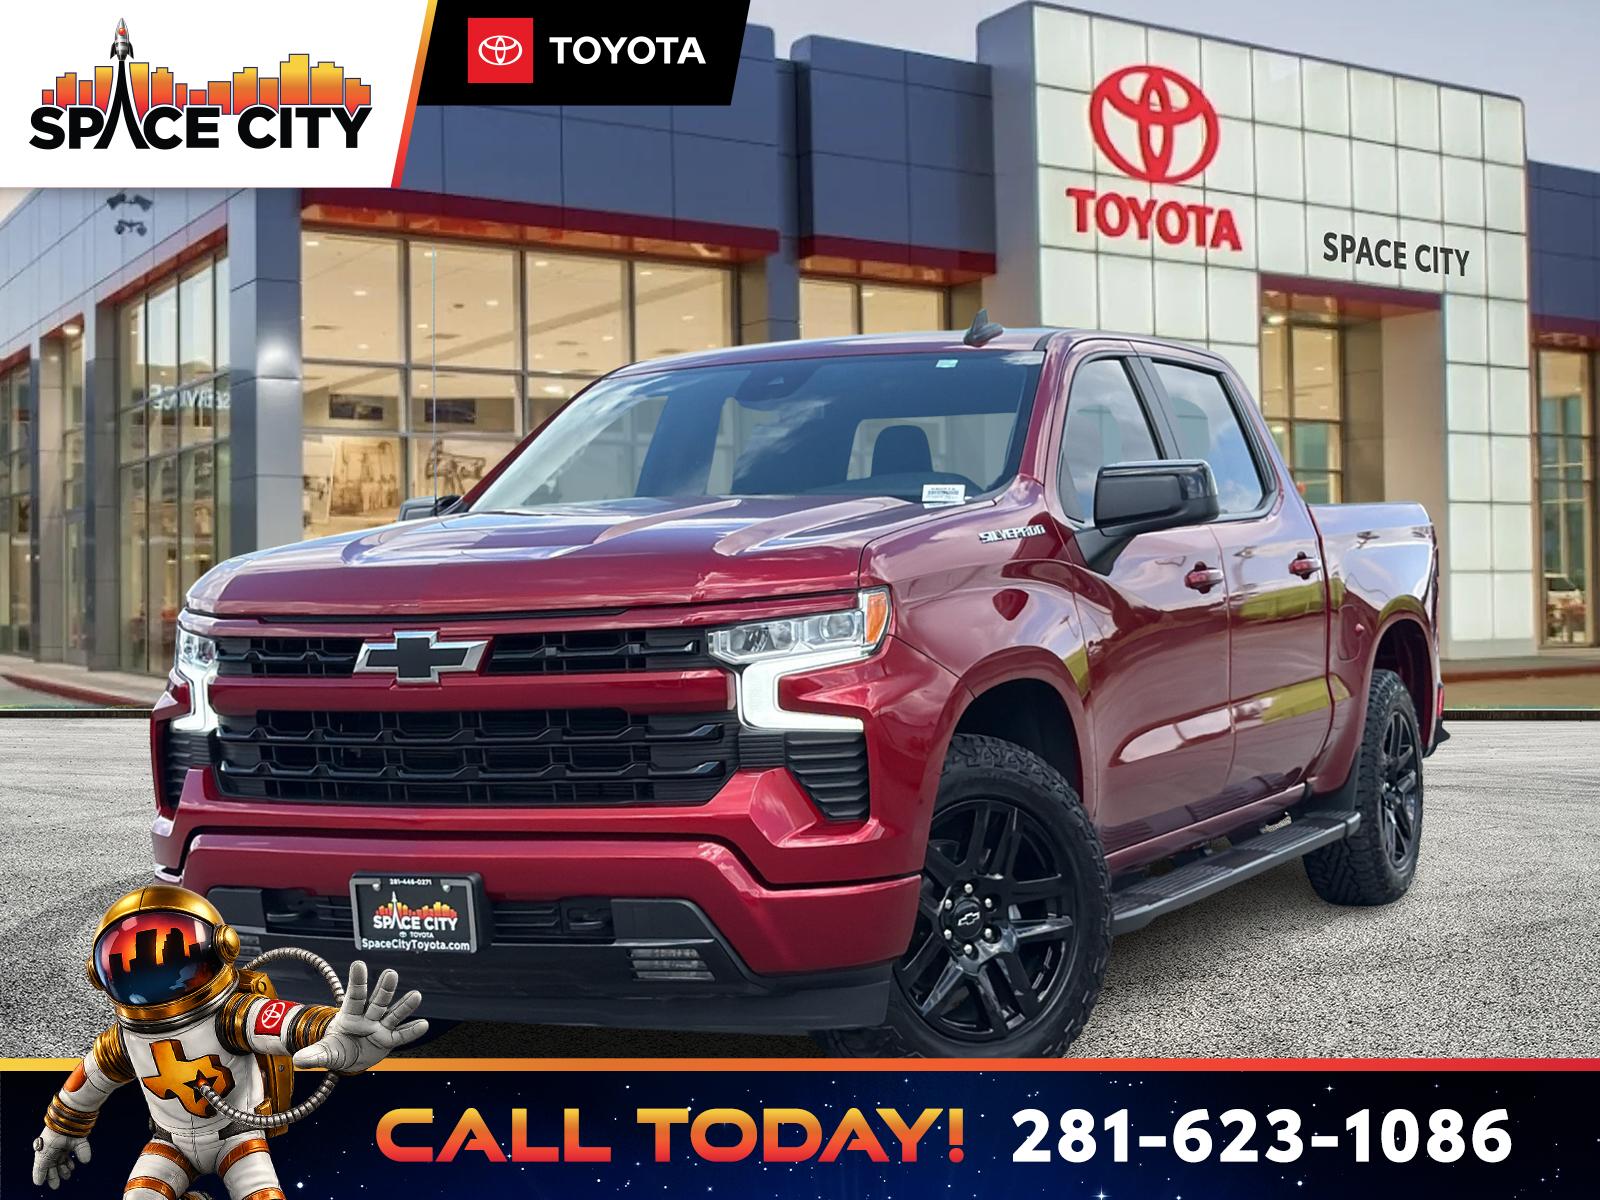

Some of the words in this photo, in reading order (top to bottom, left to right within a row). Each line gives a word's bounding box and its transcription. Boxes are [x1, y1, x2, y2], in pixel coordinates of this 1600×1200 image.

[1066, 187, 1242, 251] TOYOTA
[1323, 231, 1407, 270] SPACE
[1414, 244, 1471, 277] CITY
[373, 912, 420, 930] SPACE
[424, 916, 458, 931] CITY
[362, 938, 470, 951] SpaceCityToyota.com
